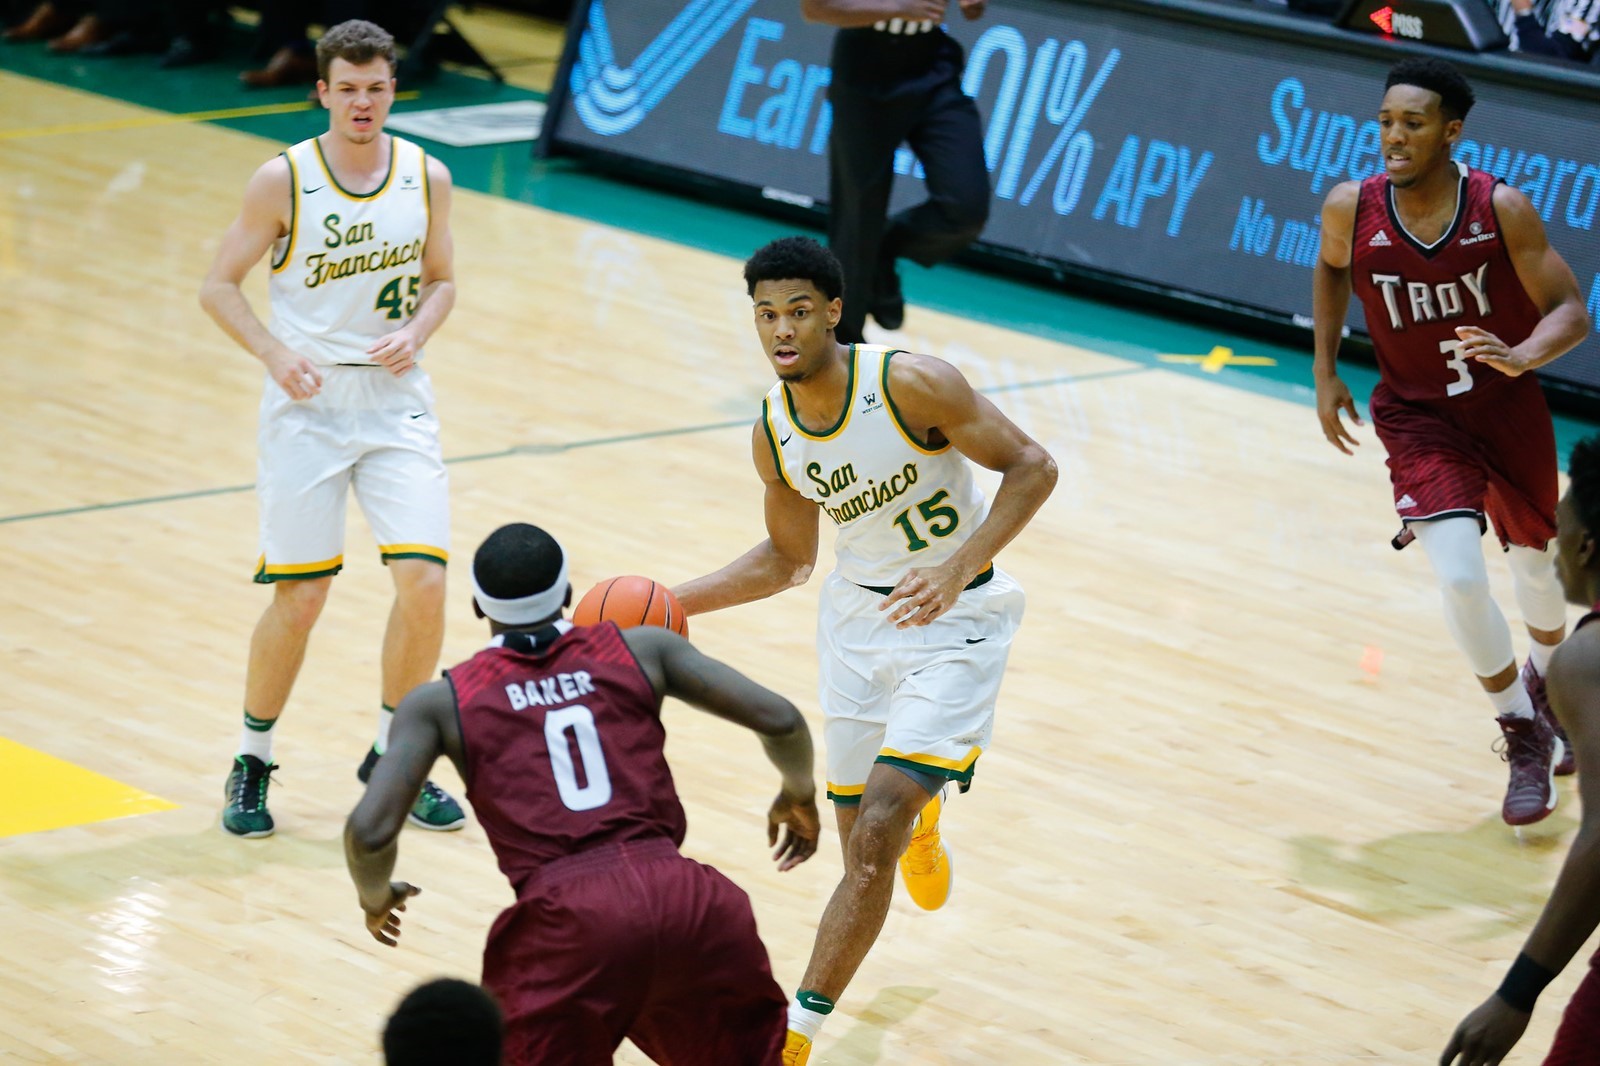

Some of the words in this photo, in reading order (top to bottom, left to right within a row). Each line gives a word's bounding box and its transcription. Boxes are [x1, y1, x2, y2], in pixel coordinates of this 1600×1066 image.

[1257, 77, 1386, 194] Supe
[1091, 134, 1214, 237] APY
[323, 213, 374, 249] San
[1229, 196, 1275, 256] No
[304, 238, 421, 288] Francisco
[374, 275, 421, 320] 45
[1371, 262, 1493, 331] TROY
[1439, 338, 1475, 397] 3
[806, 462, 858, 498] San
[893, 488, 960, 552] 15
[505, 670, 597, 711] BAKER
[544, 704, 612, 812] 0
